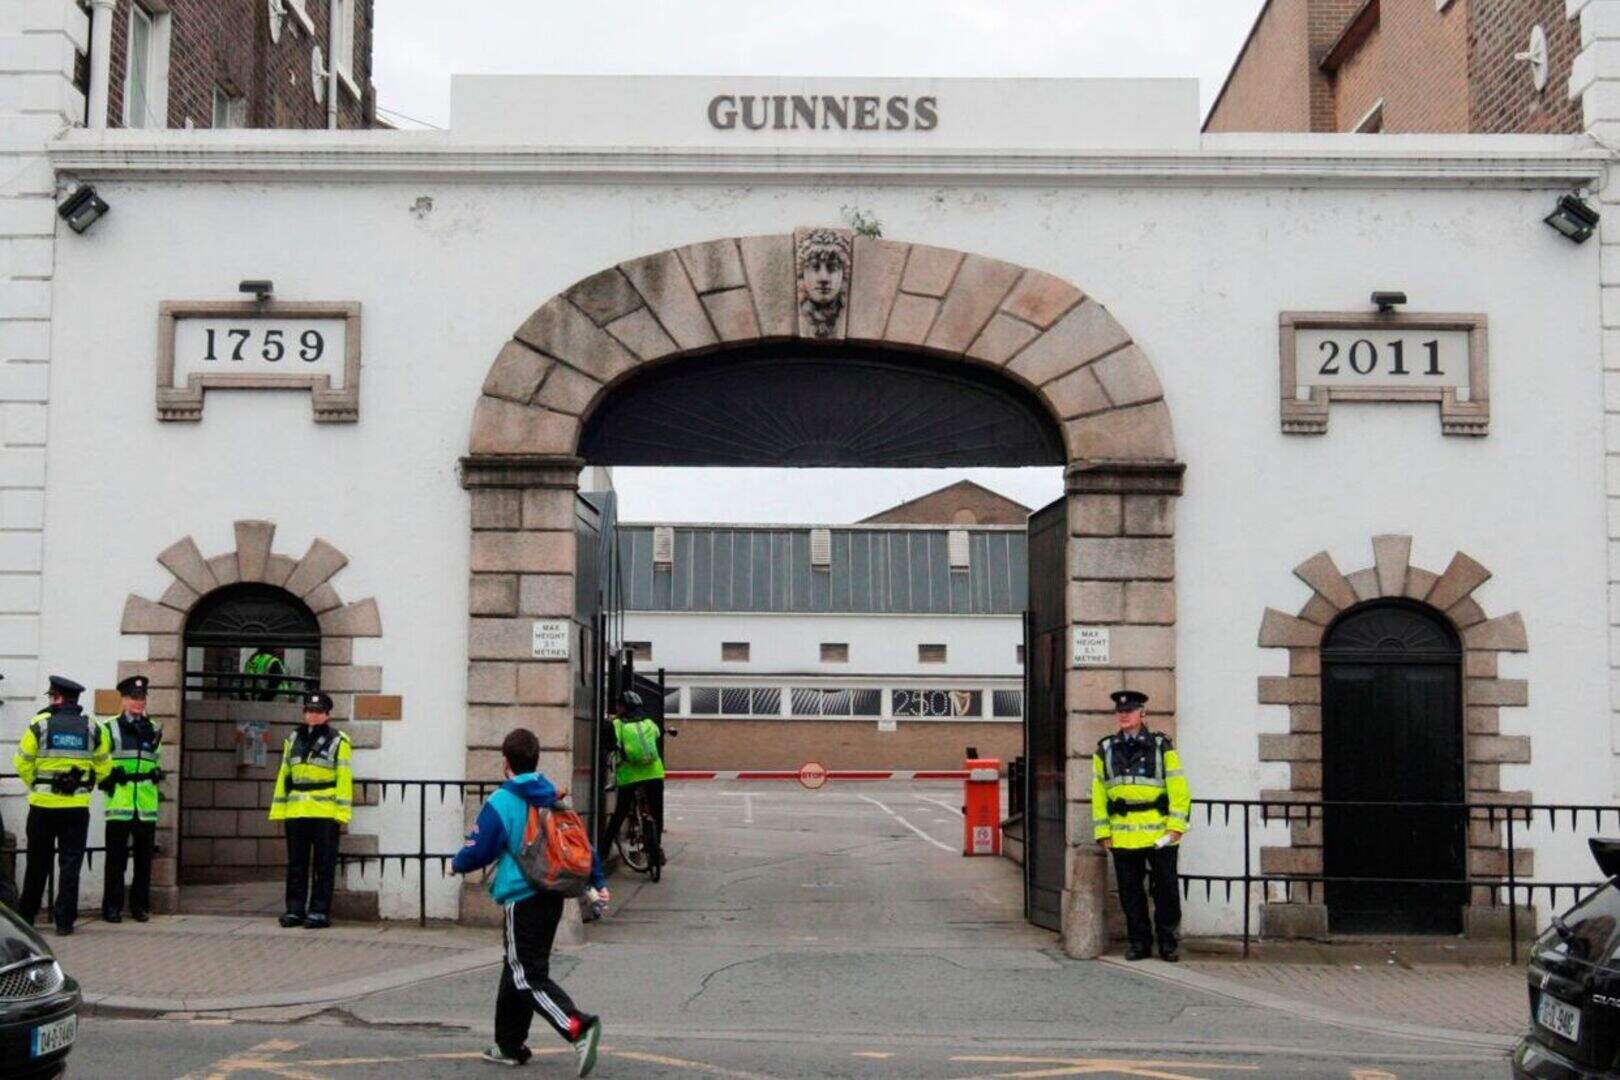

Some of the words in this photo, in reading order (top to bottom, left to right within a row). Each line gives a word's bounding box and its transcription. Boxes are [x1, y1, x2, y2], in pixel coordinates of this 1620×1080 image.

[707, 95, 938, 130] GUINNESS
[204, 328, 324, 362] 1759
[1318, 339, 1445, 375] 2011
[535, 632, 565, 640] HEIGHT
[534, 648, 567, 656] METRES
[894, 689, 948, 716] 250
[801, 771, 822, 779] STOP
